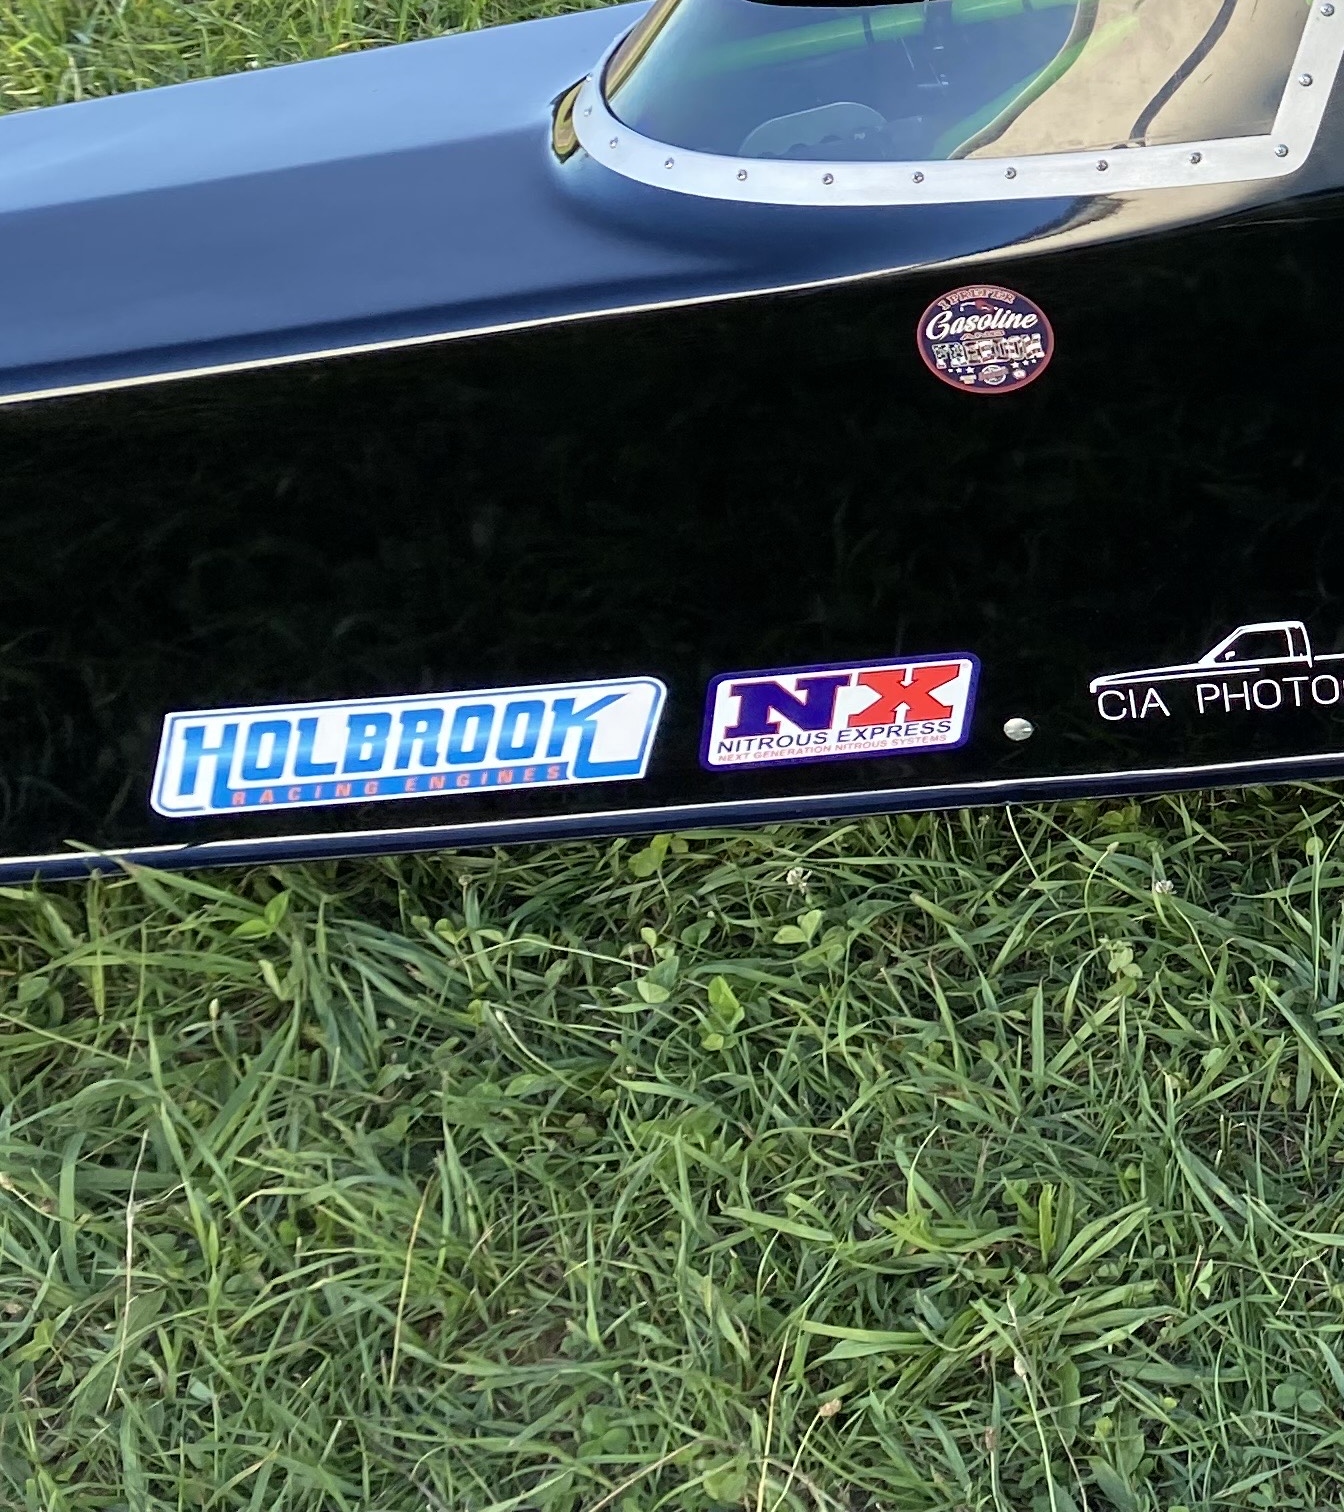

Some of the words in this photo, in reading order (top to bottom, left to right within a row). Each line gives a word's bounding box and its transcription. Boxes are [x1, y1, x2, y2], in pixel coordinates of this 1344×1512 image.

[925, 306, 1039, 341] Gasoline
[723, 663, 961, 739] NX
[1097, 687, 1171, 721] CIA
[177, 692, 632, 796] HOLBROOK
[717, 730, 828, 755] NITROUS
[837, 719, 952, 743] EXPRESS
[717, 753, 750, 763] NEXT
[754, 744, 832, 760] GENERATION
[835, 739, 886, 752] NITROUS
[887, 734, 948, 747] SYSTEMS
[231, 779, 379, 806] RACING
[404, 764, 560, 793] ENGINES
